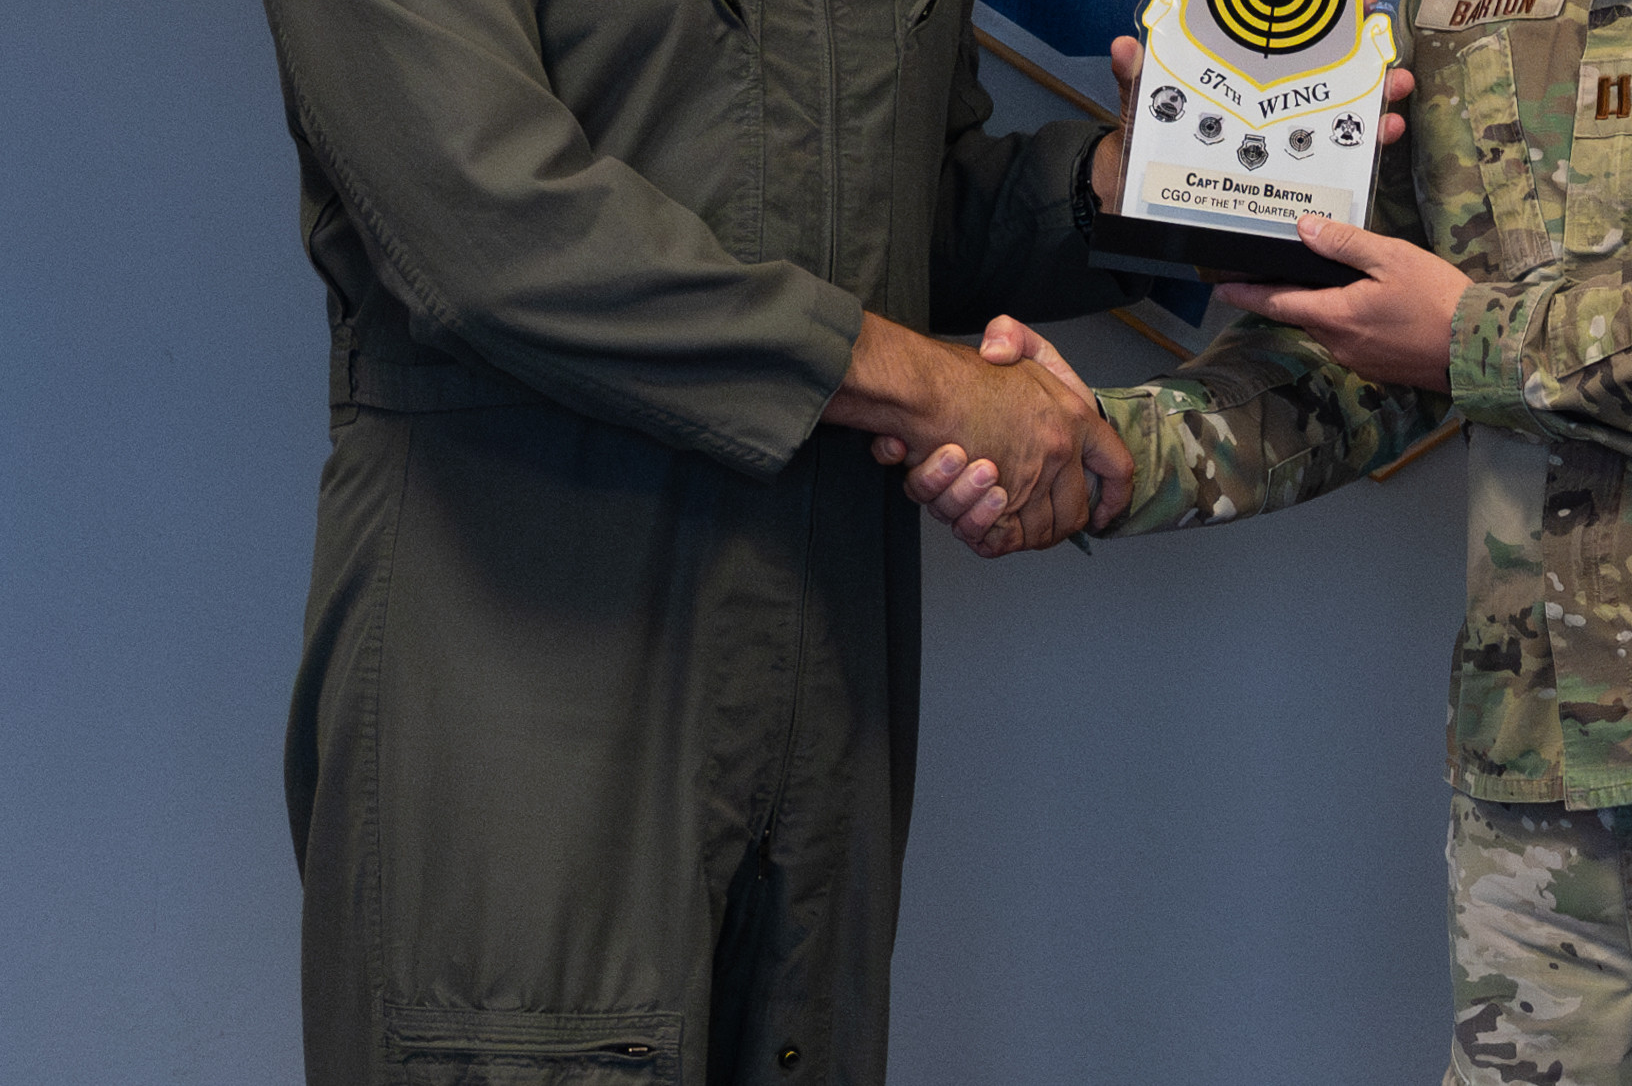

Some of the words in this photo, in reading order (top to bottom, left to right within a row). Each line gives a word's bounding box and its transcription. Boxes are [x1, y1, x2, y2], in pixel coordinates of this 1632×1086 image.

[1199, 67, 1242, 107] 57TH
[1257, 82, 1331, 120] WING
[1161, 188, 1192, 203] CGO
[1194, 195, 1206, 205] OF
[1210, 197, 1229, 209] THE
[1247, 200, 1298, 221] QUARTER,
[1185, 172, 1220, 190] CAPT
[1221, 177, 1260, 196] DAVID
[1263, 183, 1313, 204] BARTON
